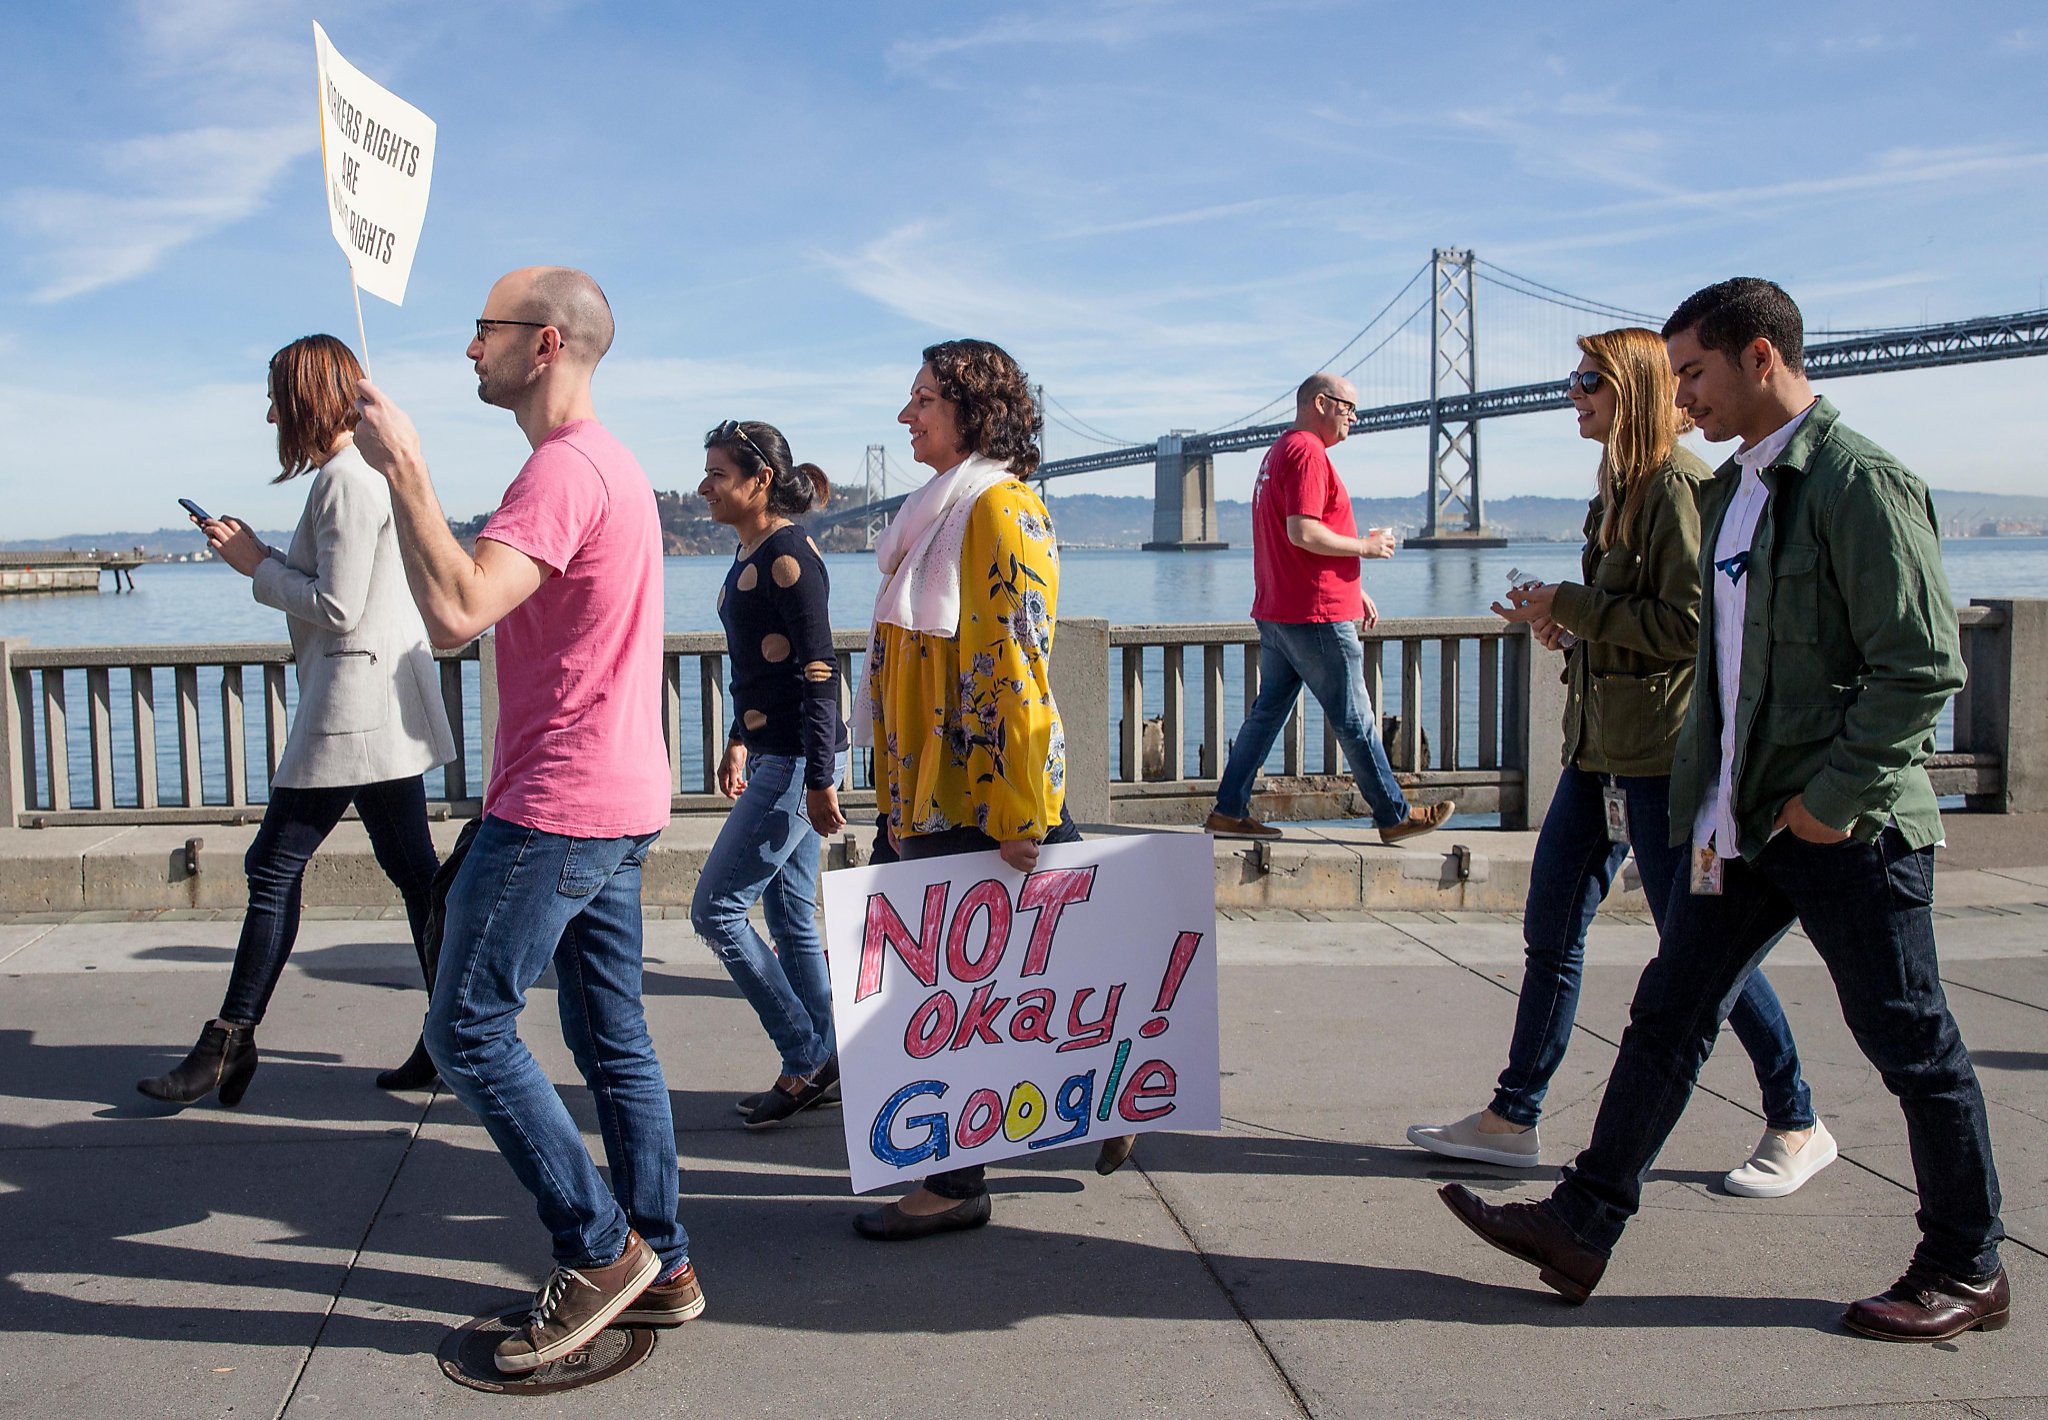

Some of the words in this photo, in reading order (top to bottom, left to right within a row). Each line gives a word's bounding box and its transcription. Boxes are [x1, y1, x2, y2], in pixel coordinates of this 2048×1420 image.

[342, 151, 360, 196] ARE
[363, 118, 420, 178] RIGHTS
[350, 210, 395, 265] RIGHTS
[855, 865, 1099, 1003] NOT
[870, 1038, 1177, 1169] Google
